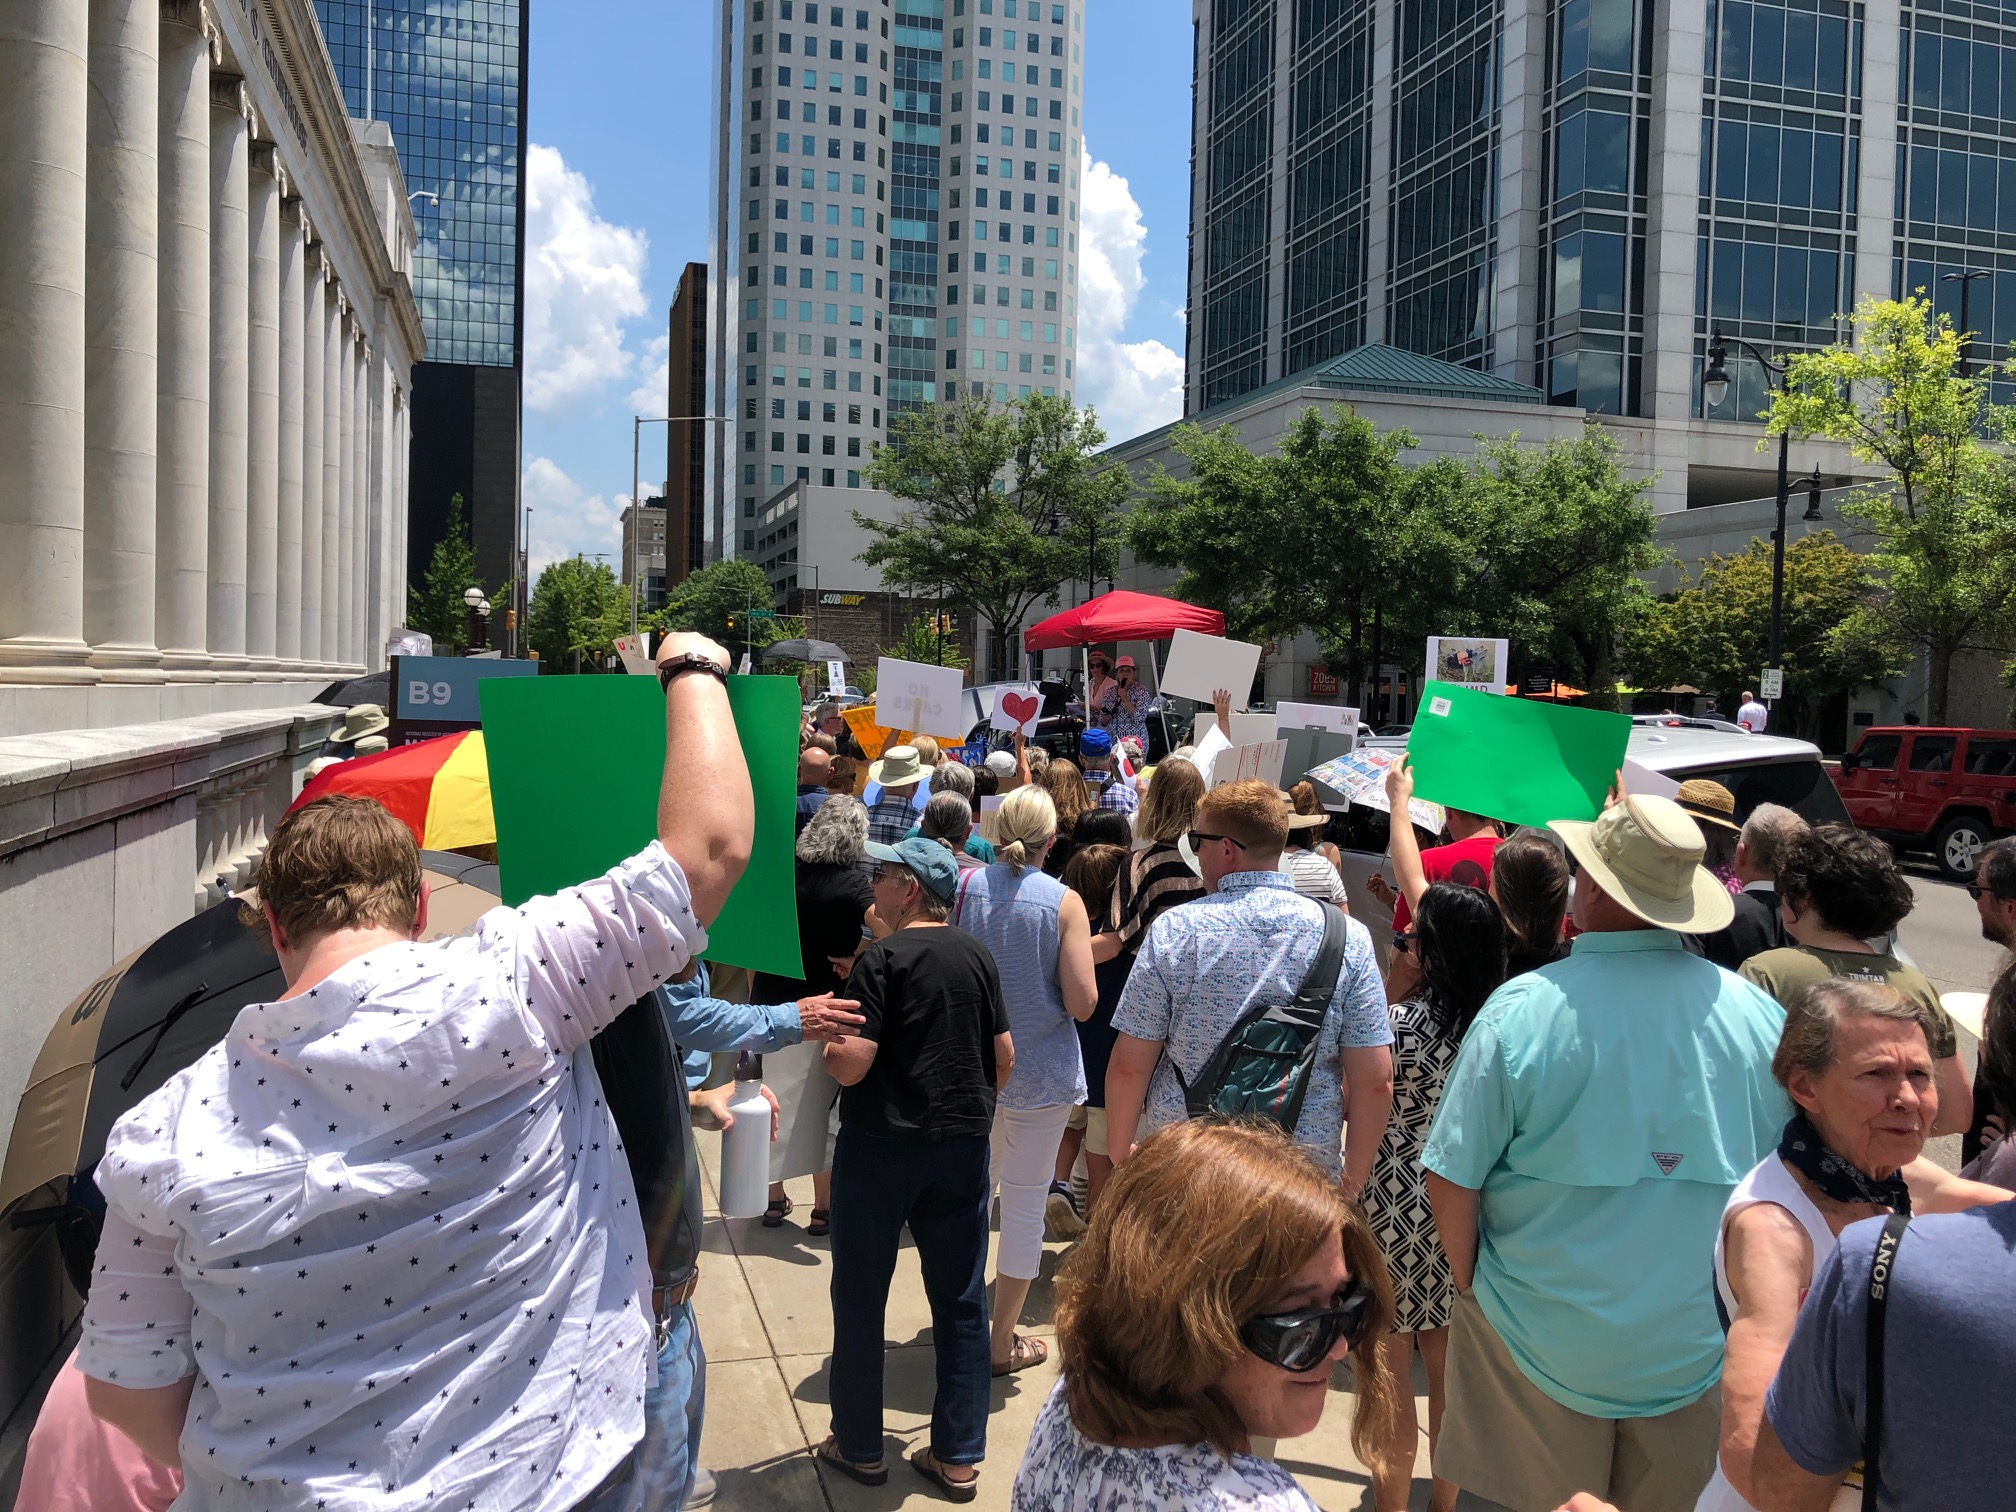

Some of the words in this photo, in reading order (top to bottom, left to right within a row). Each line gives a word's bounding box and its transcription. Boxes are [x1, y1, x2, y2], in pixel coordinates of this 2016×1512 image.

[820, 593, 865, 605] SUBWAY
[409, 681, 452, 706] B9
[1312, 684, 1336, 692] KITCHEN
[1848, 972, 1885, 983] TRIMTAB
[1871, 1231, 1897, 1300] SONY
